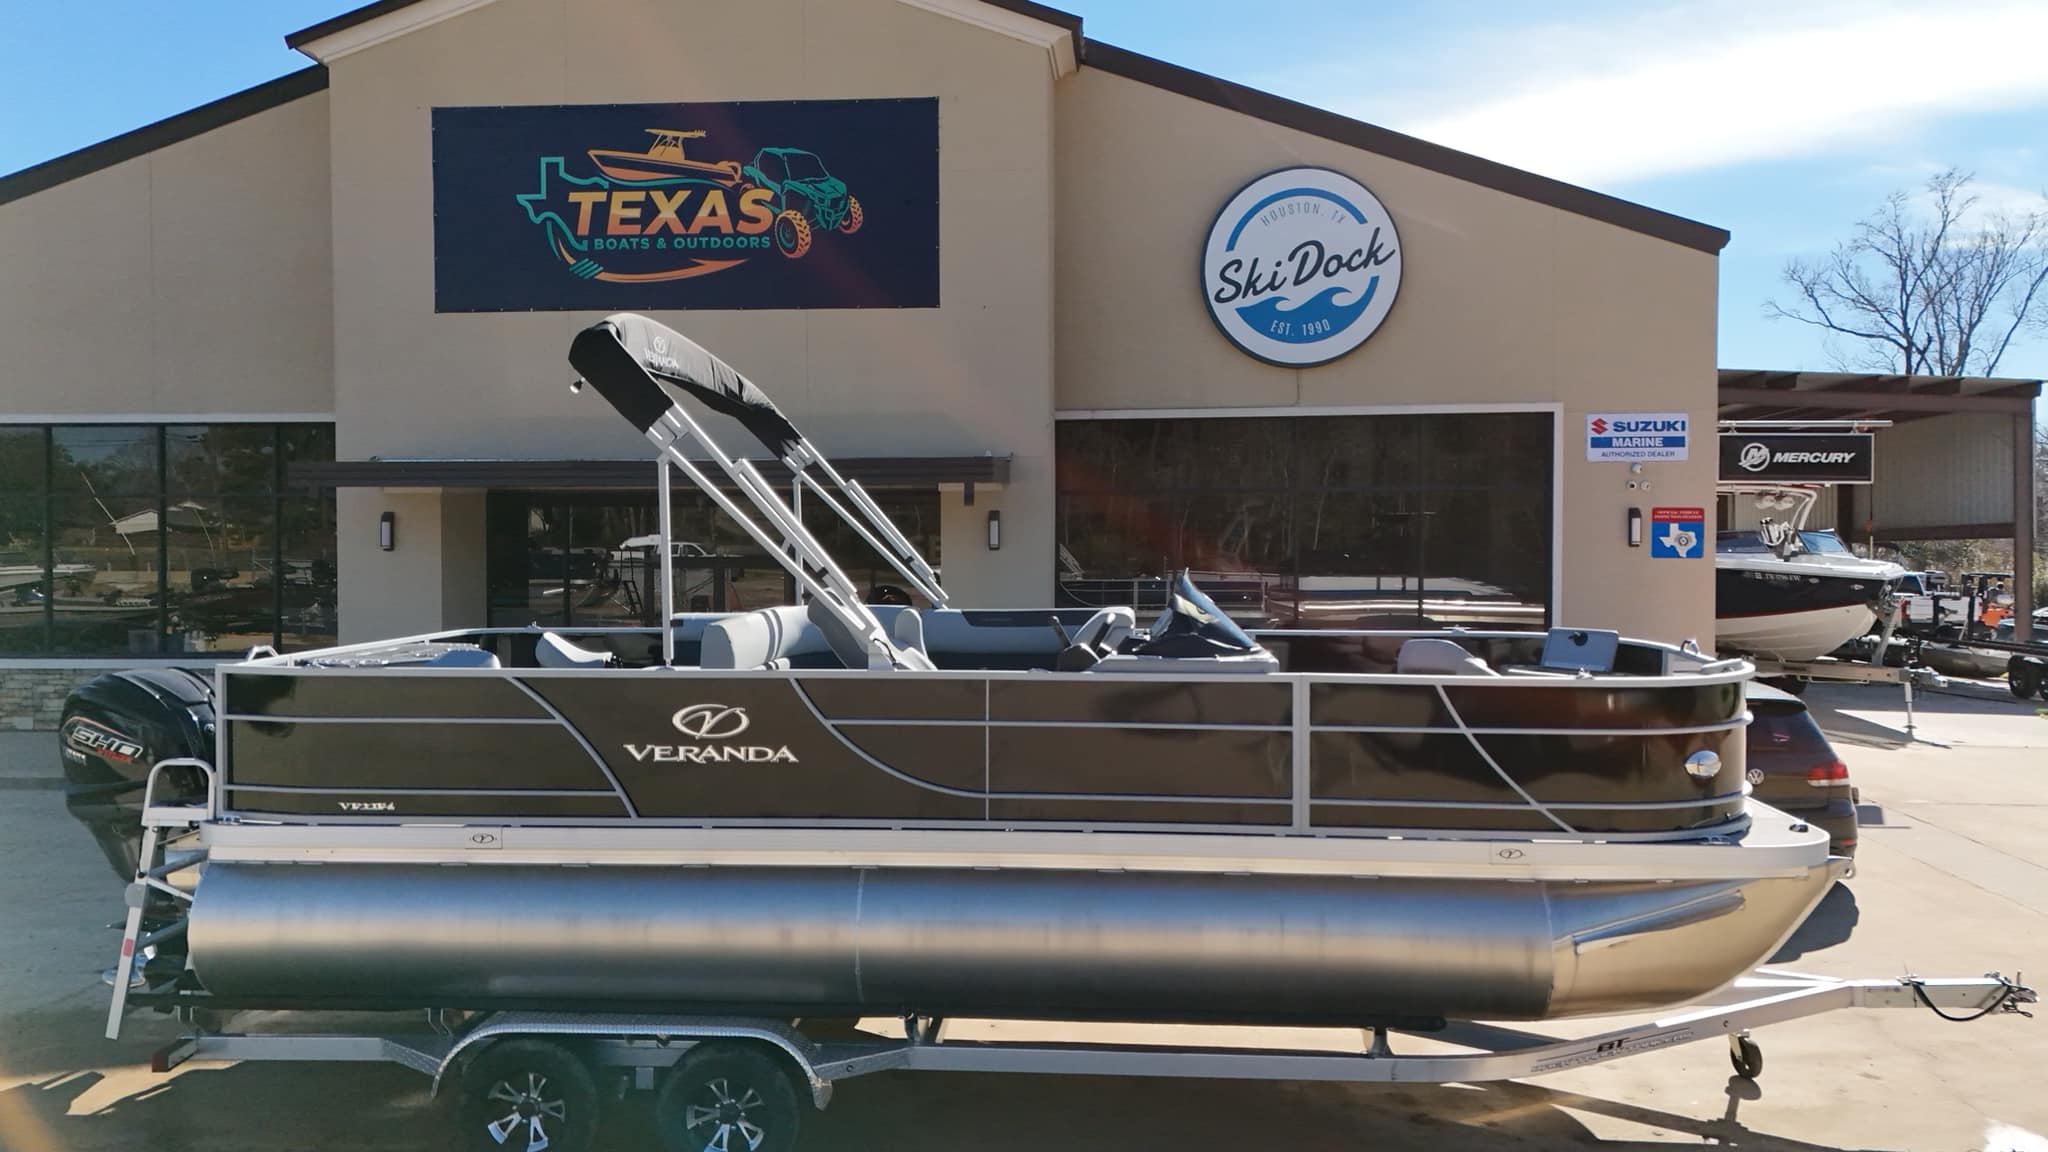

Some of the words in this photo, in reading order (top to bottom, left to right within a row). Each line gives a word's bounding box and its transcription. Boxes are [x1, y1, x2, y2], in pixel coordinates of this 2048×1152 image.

[568, 189, 775, 236] TEXAS
[1332, 210, 1346, 224] TX
[593, 238, 650, 250] BOATS
[656, 238, 666, 249] &
[673, 236, 771, 249] OUTDOORS
[1214, 257, 1287, 304] Ski
[1288, 227, 1396, 286] Dock
[1270, 319, 1295, 337] EST.
[1301, 318, 1331, 336] 1990
[1612, 420, 1686, 432] SUZUKI
[1612, 437, 1663, 447] MARINE
[1773, 452, 1856, 463] MERCURY
[623, 744, 799, 763] VERANDA
